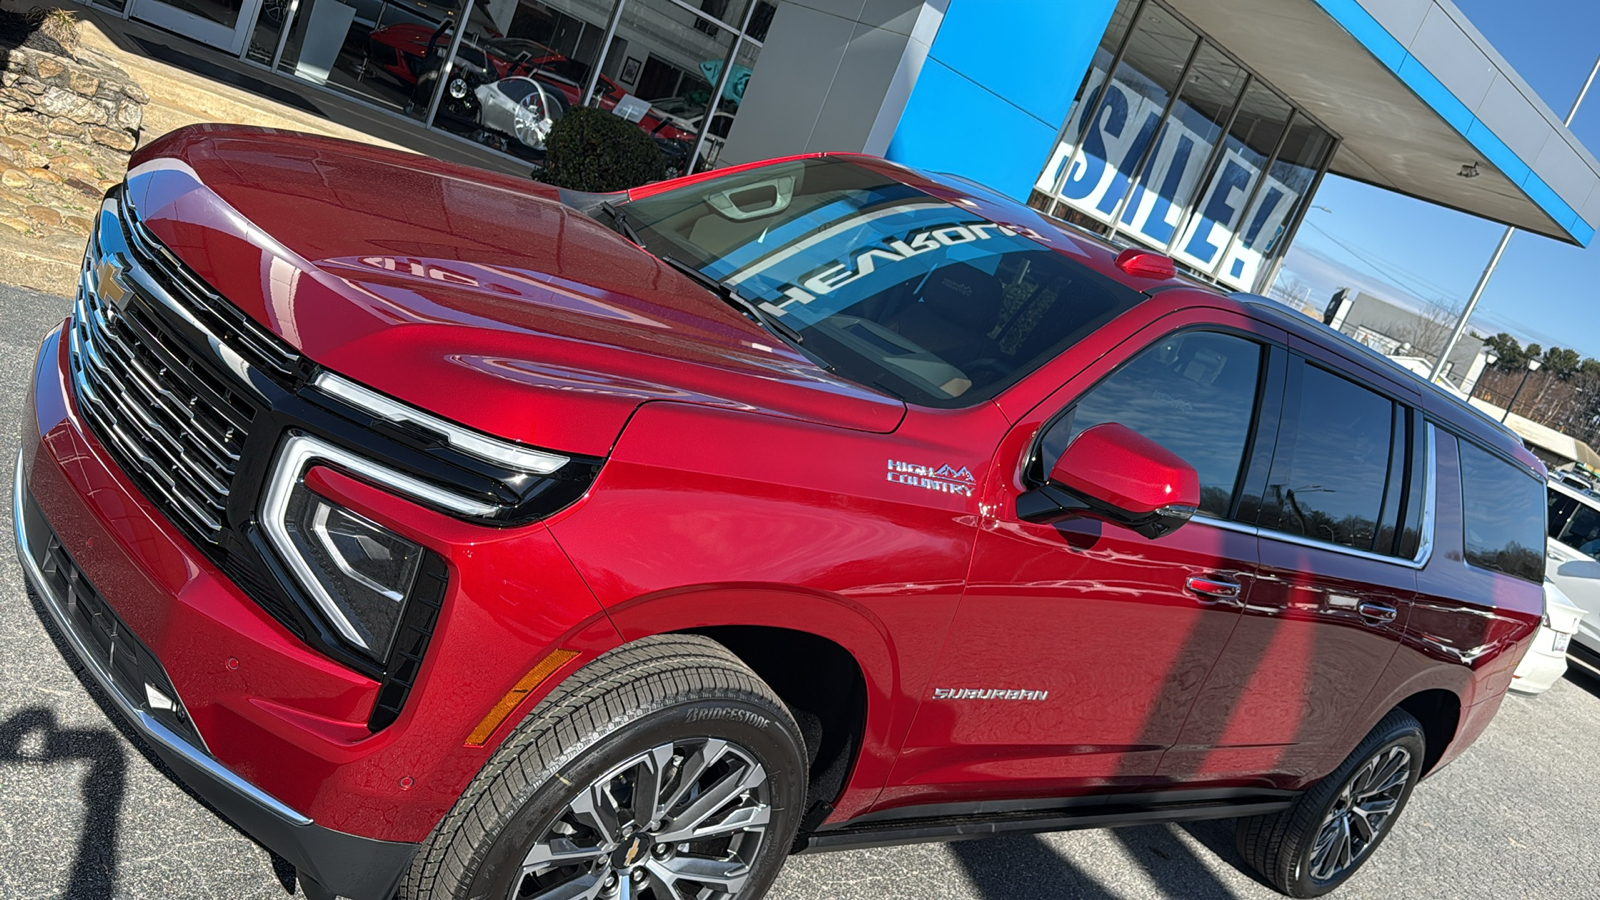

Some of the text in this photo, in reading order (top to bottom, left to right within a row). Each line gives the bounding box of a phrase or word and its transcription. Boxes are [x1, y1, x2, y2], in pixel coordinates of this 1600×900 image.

[1059, 83, 1284, 280] SALE!
[887, 459, 935, 477] HIGH
[886, 471, 975, 497] COUNTRY
[932, 687, 1049, 701] SUBURBAN
[684, 707, 771, 732] BRIDGESTONE
